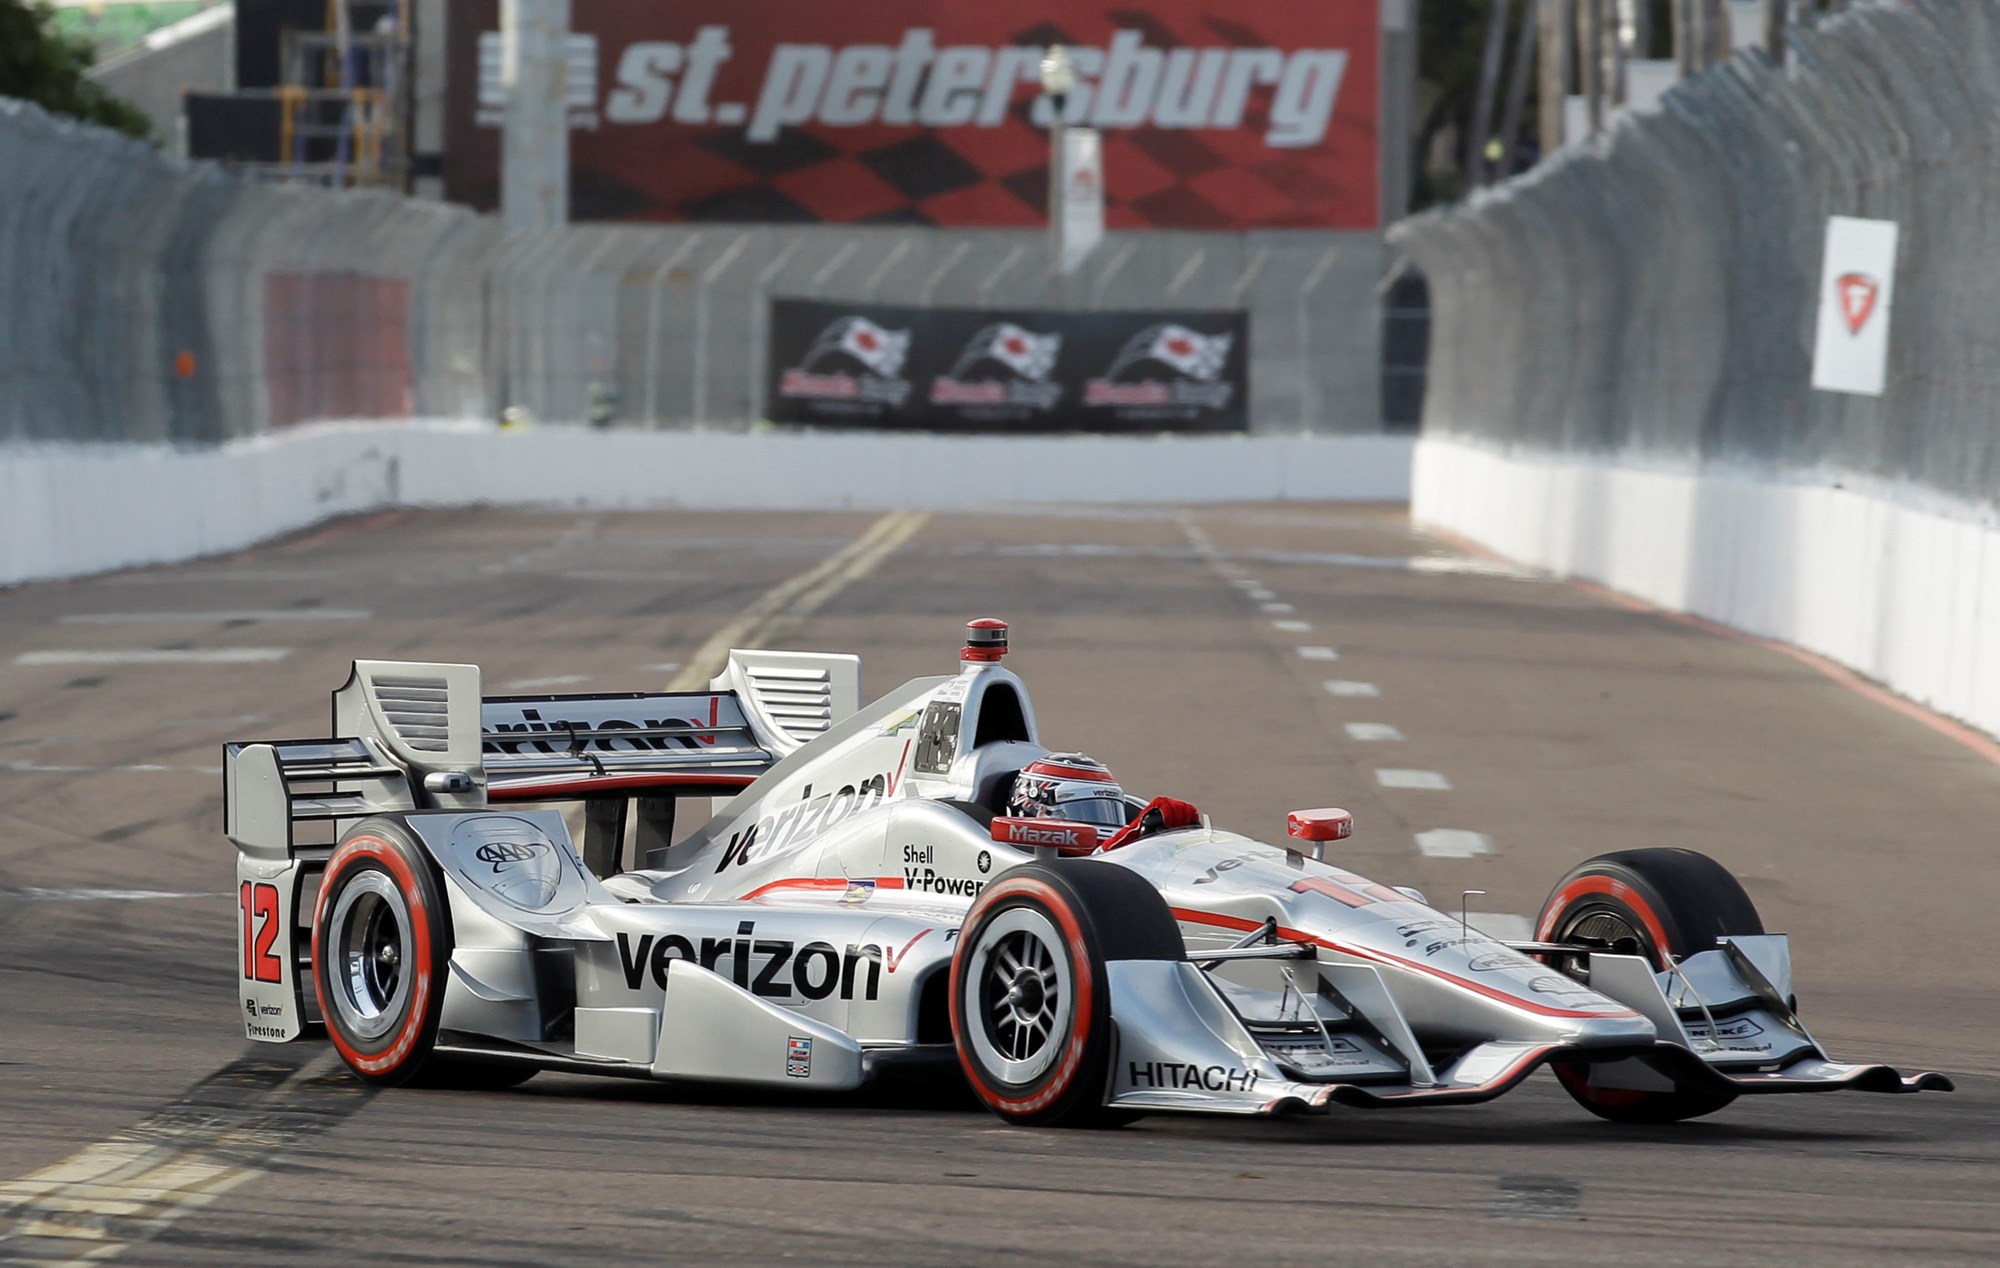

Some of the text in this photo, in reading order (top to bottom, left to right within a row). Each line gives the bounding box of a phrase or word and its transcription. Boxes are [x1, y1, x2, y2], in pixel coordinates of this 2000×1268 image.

[482, 709, 702, 753] rizon
[714, 773, 885, 874] verizon
[1008, 824, 1080, 845] Mazak
[482, 843, 530, 861] AAA
[904, 844, 933, 864] Shell
[904, 867, 984, 898] V-Power
[240, 879, 282, 984] 12
[616, 921, 883, 1001] verizon
[247, 1022, 286, 1038] Firestone
[1129, 1061, 1258, 1092] HITACHI
